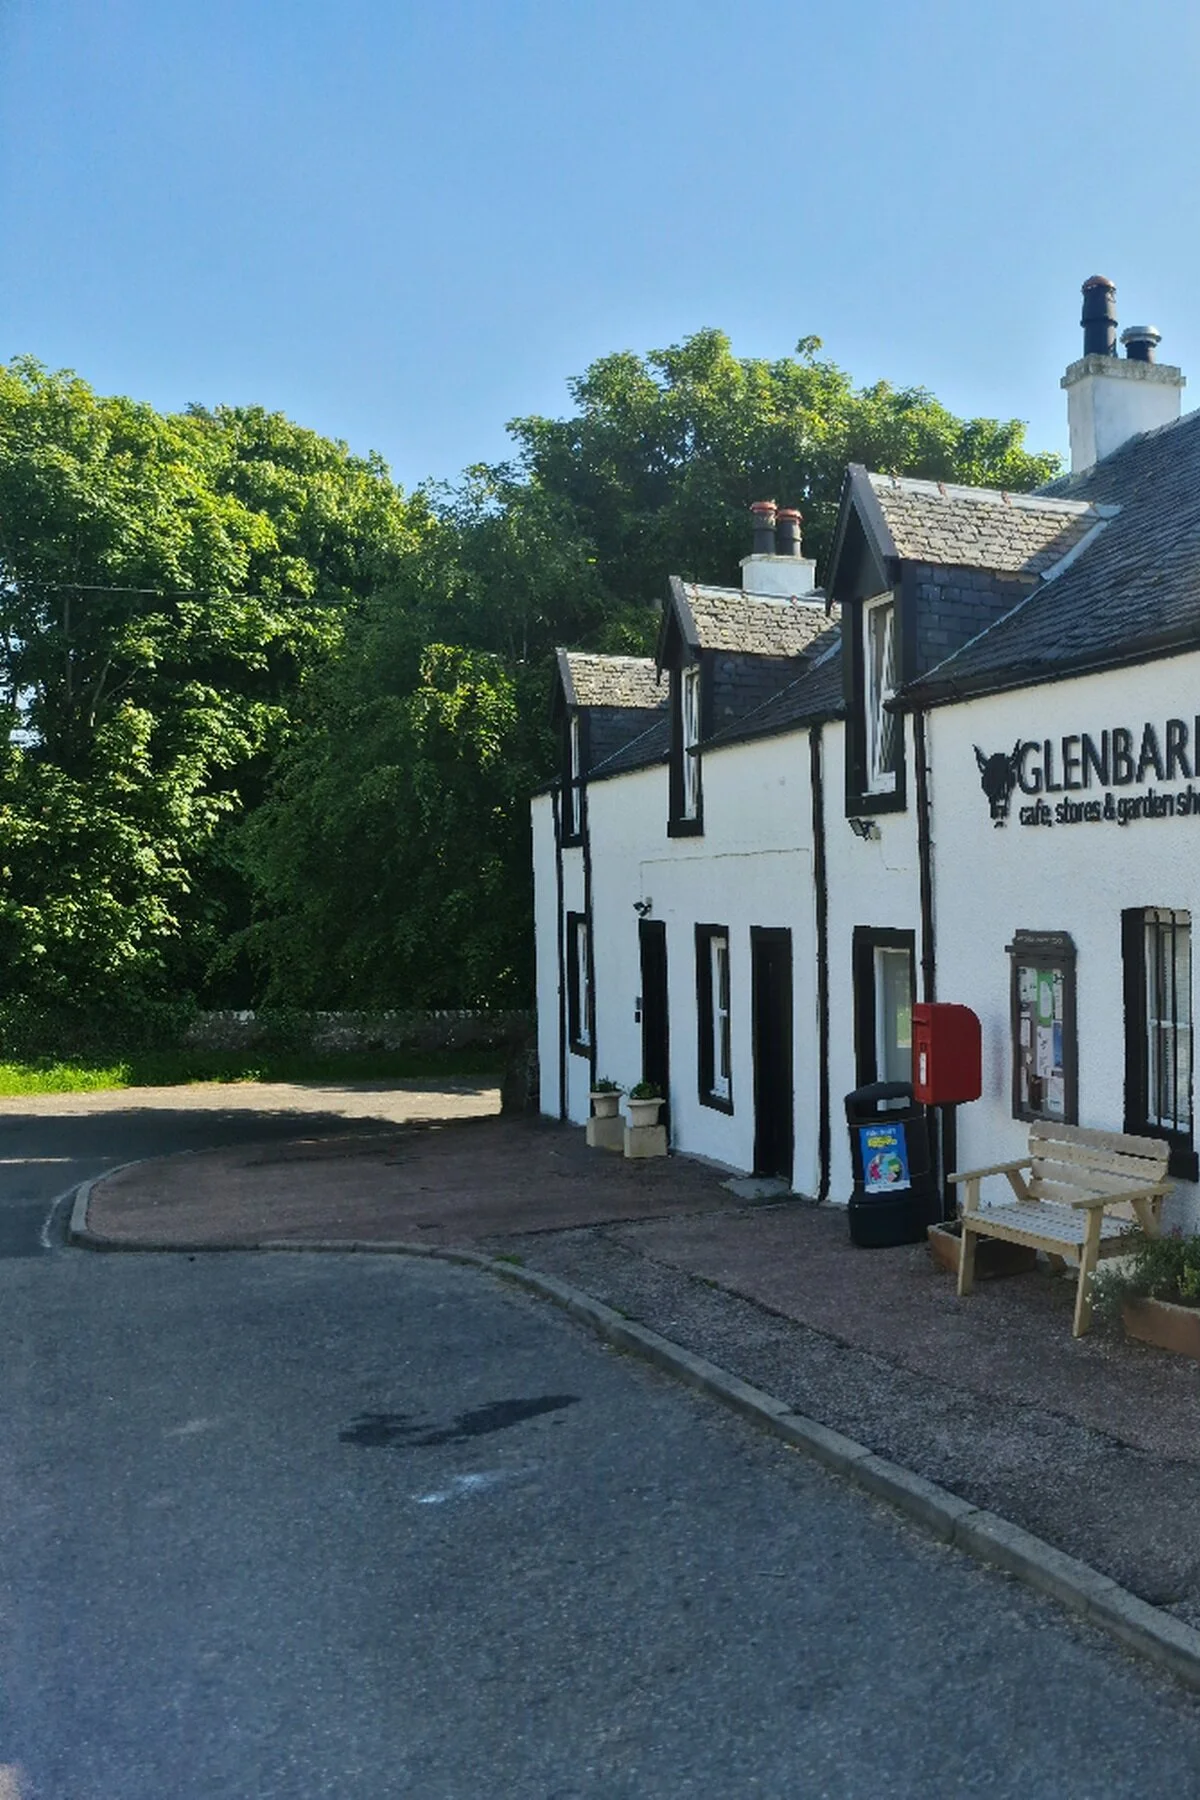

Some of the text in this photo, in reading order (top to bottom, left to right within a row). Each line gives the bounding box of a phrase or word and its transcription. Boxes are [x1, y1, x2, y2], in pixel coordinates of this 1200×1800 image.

[1055, 796, 1100, 824] stores
[1103, 792, 1116, 819] &
[1117, 788, 1174, 826] garden
